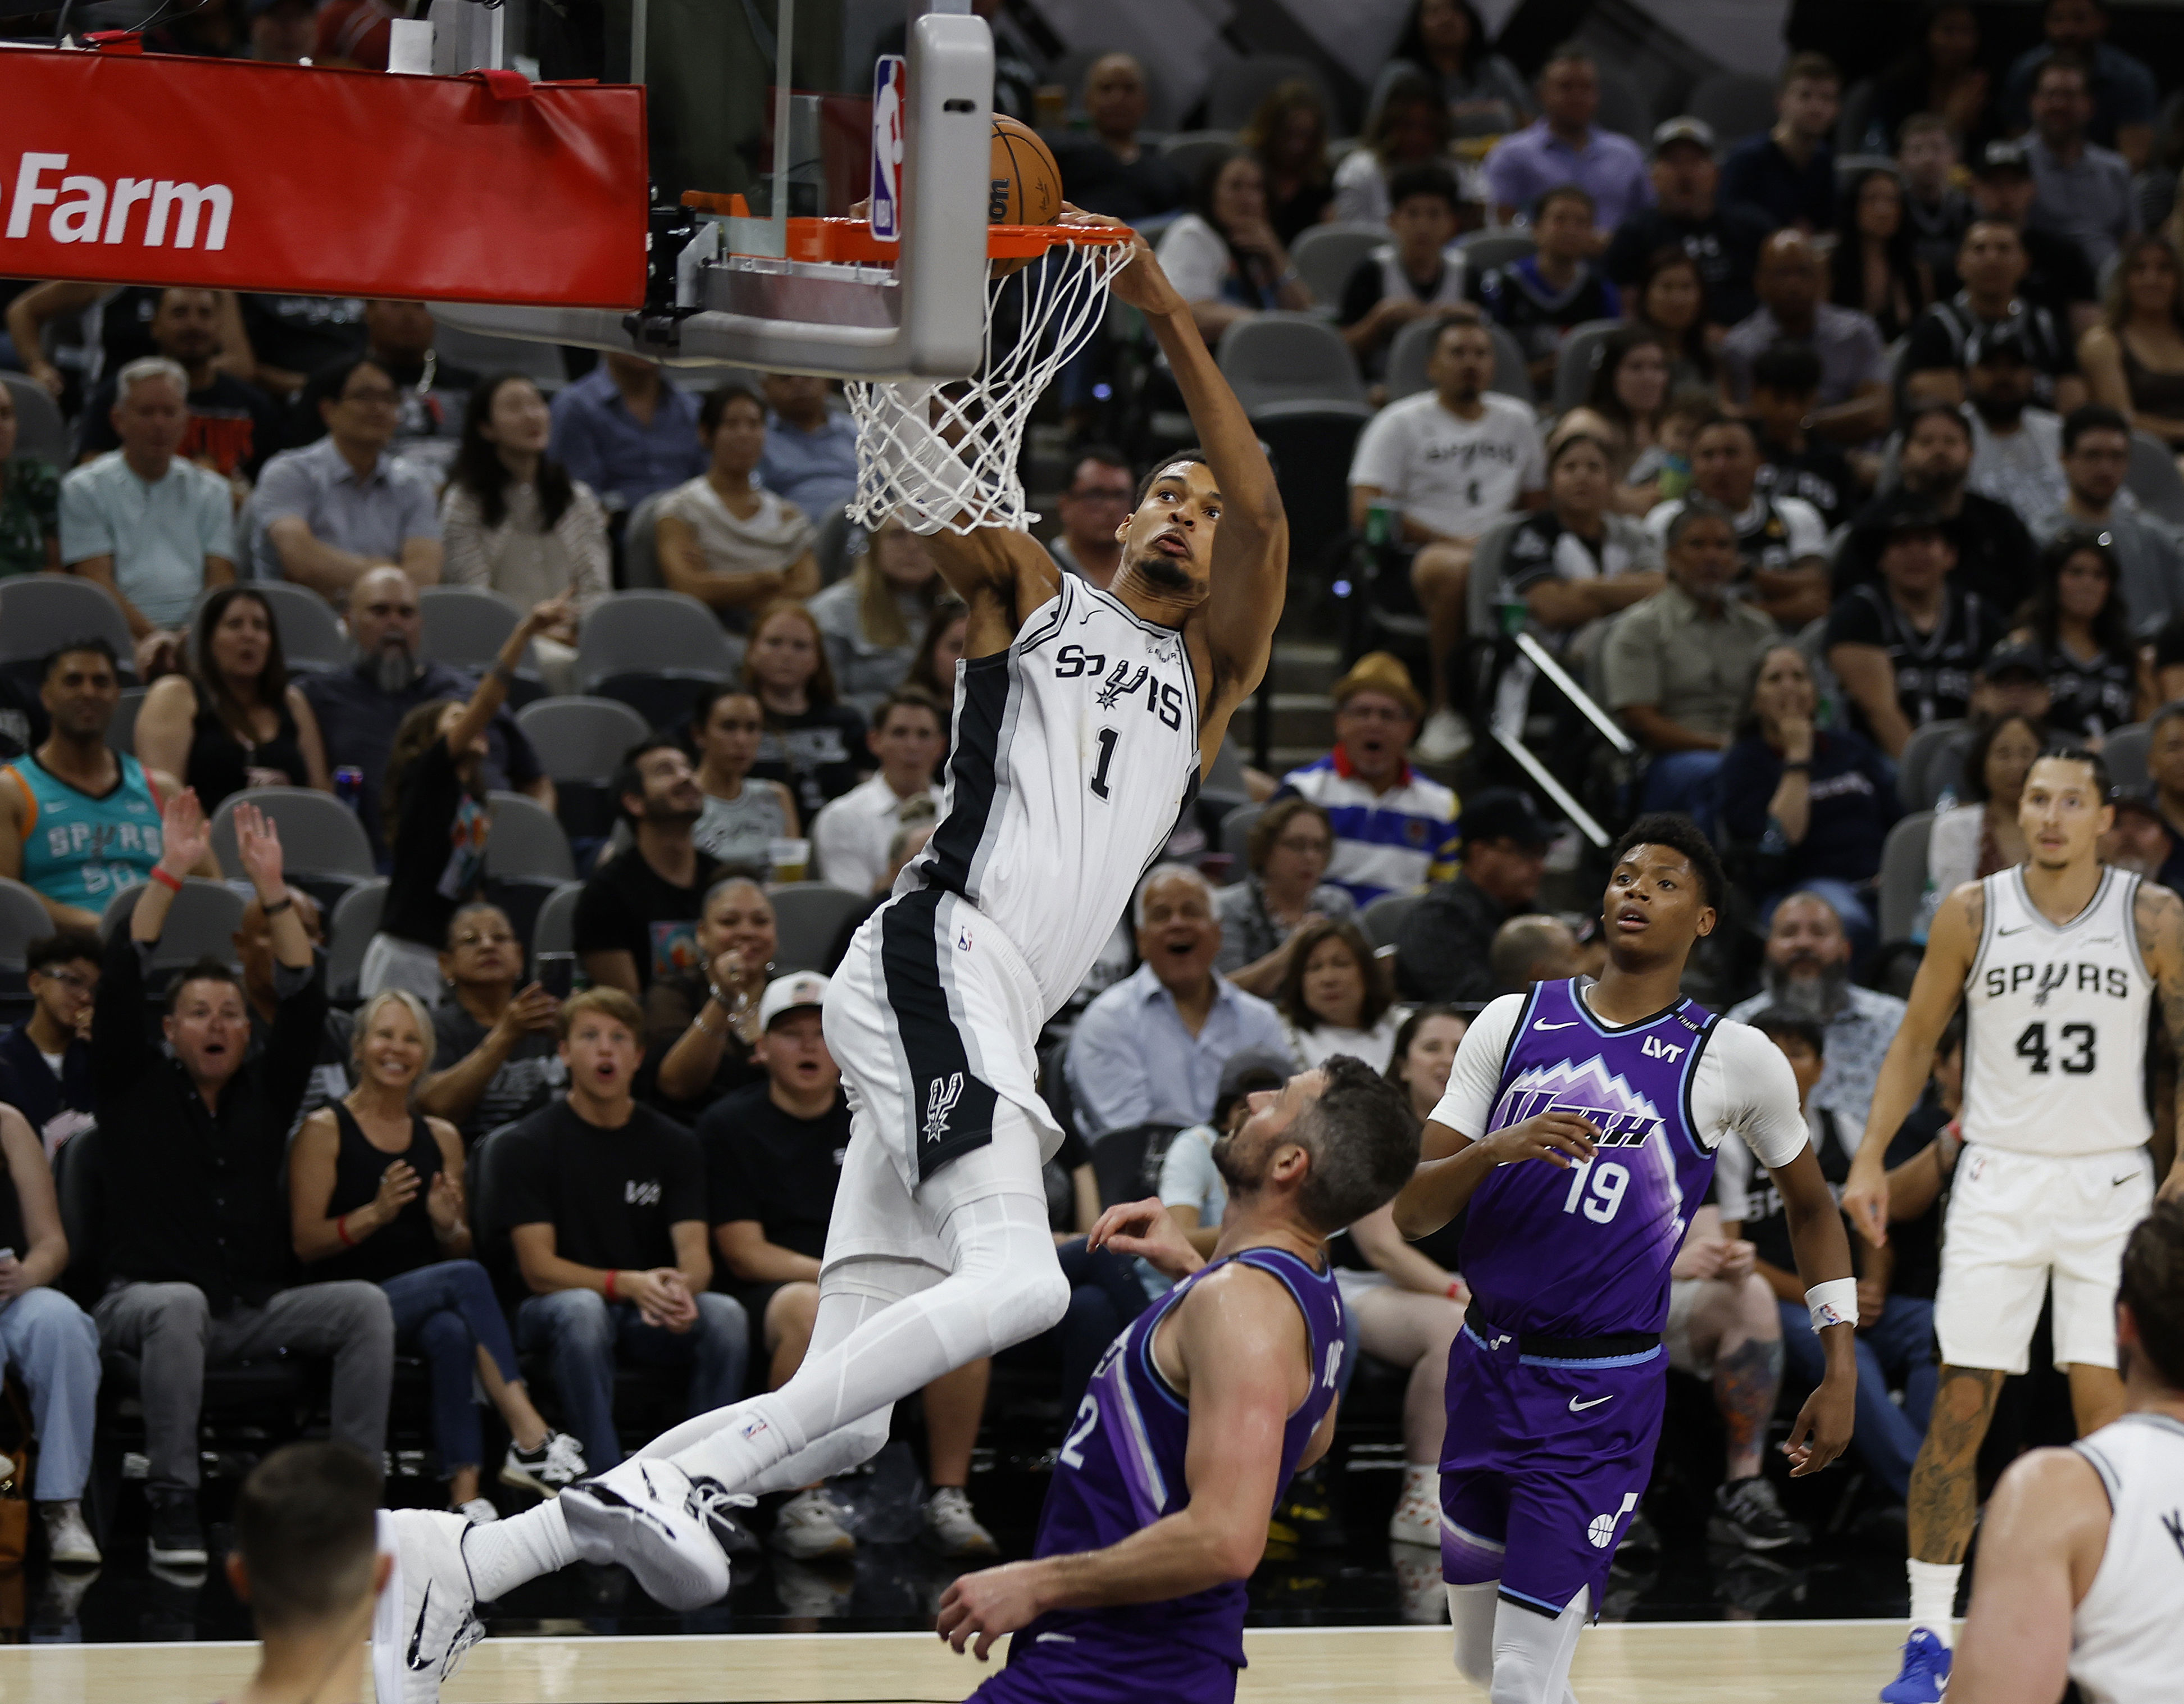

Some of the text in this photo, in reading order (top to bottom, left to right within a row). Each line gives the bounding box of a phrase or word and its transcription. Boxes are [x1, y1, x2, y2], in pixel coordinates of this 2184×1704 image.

[5, 152, 234, 250] Farm
[989, 178, 1010, 224] on
[1088, 725, 1122, 805] 1
[1987, 963, 2128, 1006] SPURS
[1640, 1035, 1685, 1064] LVT
[2015, 1021, 2096, 1074] 43
[1562, 1155, 1630, 1225] 19
